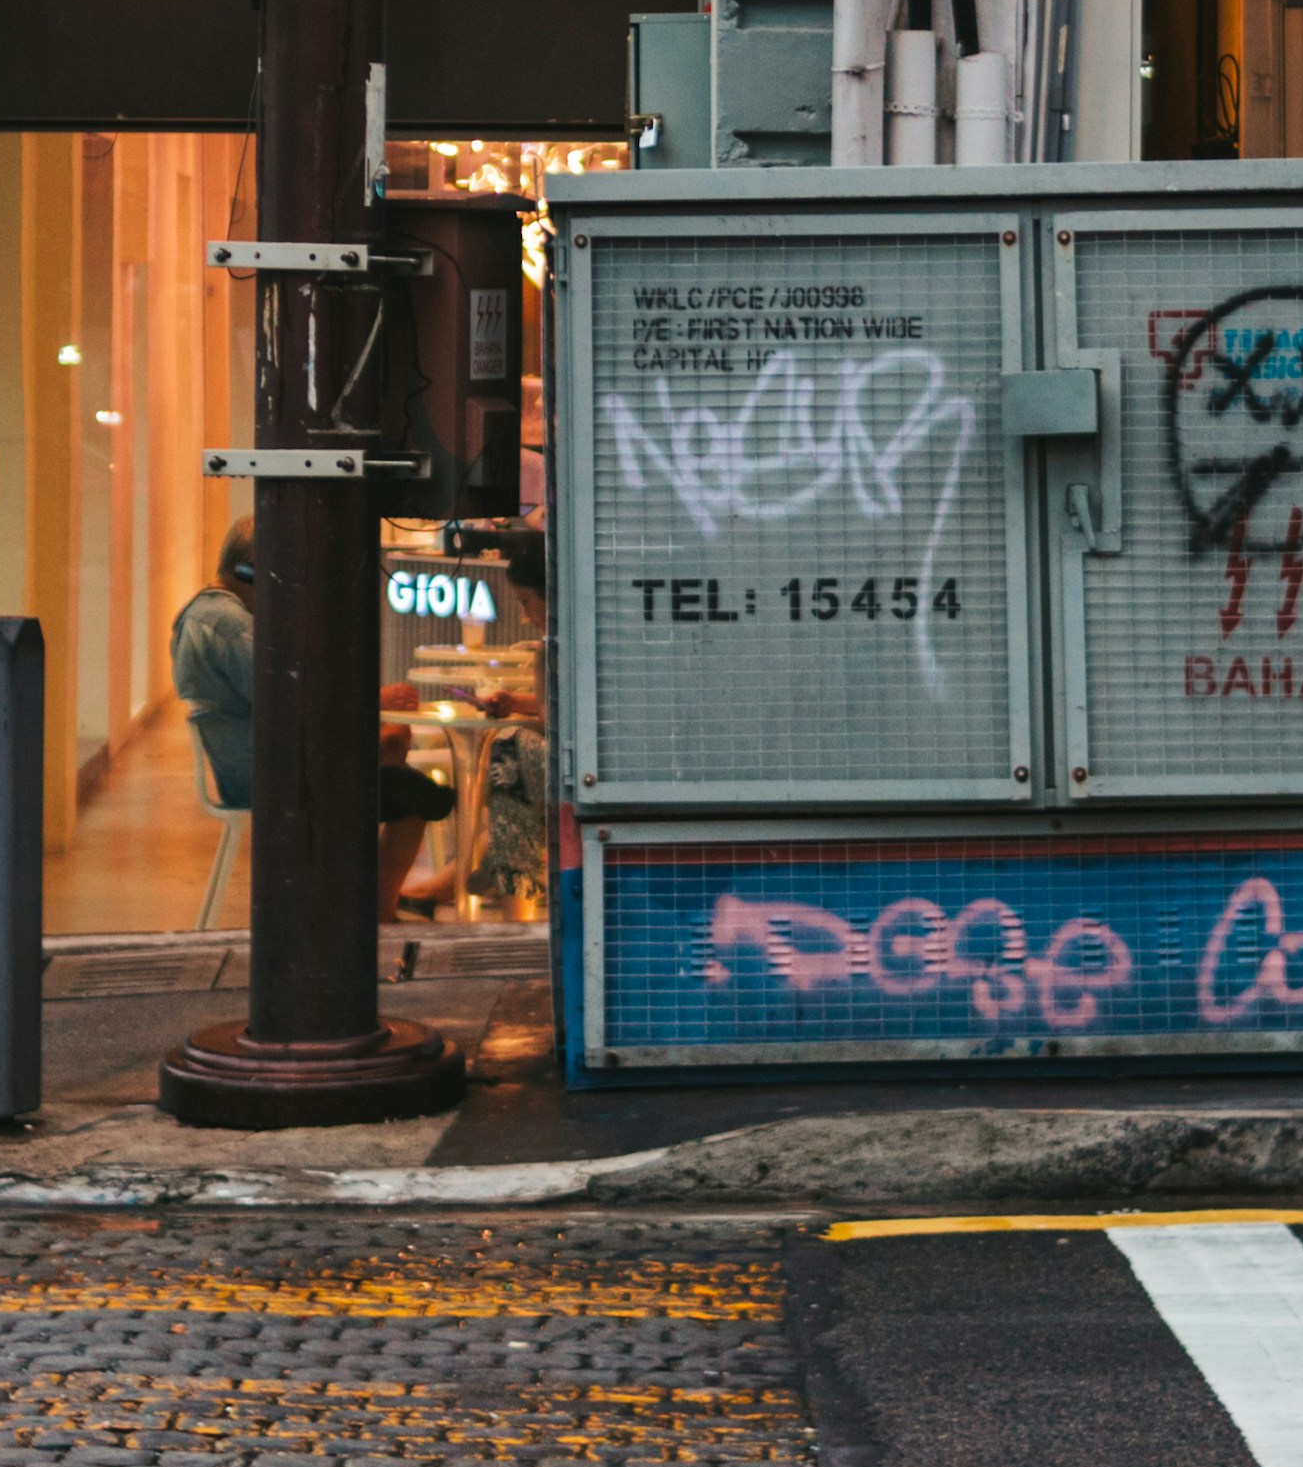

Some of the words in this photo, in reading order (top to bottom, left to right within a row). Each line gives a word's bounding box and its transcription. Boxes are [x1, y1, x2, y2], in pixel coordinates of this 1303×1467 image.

[764, 316, 853, 340] NATION
[863, 316, 923, 339] WIDE
[633, 347, 734, 372] CAPITAL
[387, 570, 497, 622] GIOIA
[632, 578, 756, 621] TEL:
[780, 576, 962, 621] 15454
